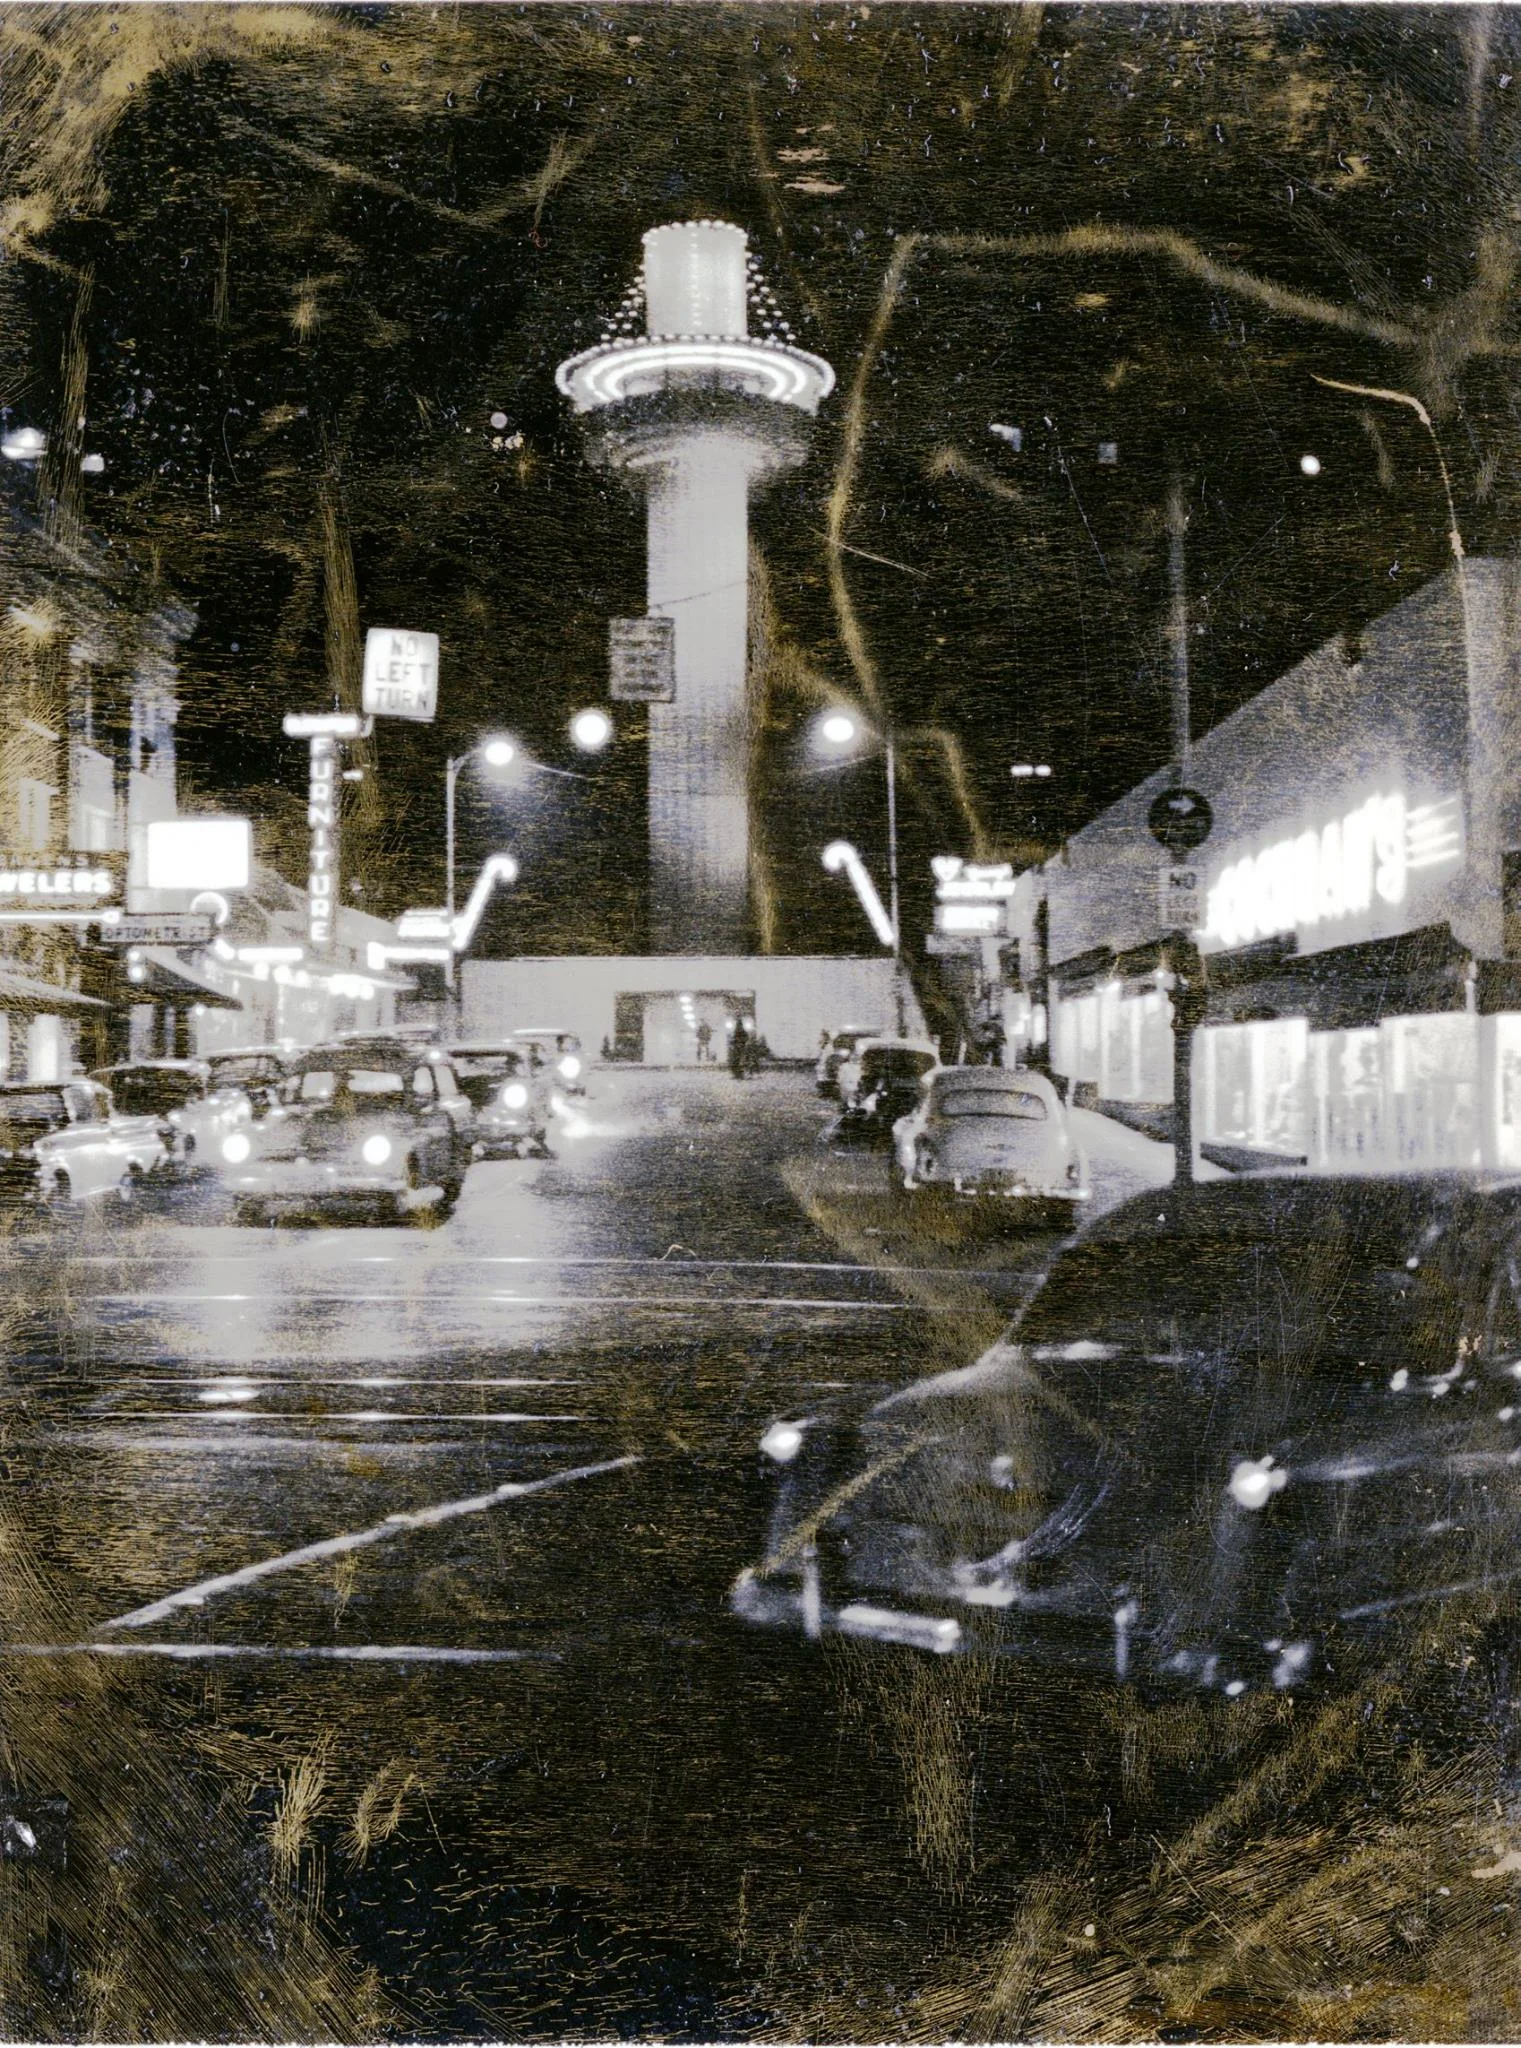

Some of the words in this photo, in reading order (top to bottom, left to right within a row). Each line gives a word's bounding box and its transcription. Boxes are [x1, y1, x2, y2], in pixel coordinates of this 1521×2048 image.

[391, 634, 419, 656] NO
[376, 661, 432, 685] LEFT
[375, 687, 431, 711] TURN
[309, 736, 332, 942] FURNITURE
